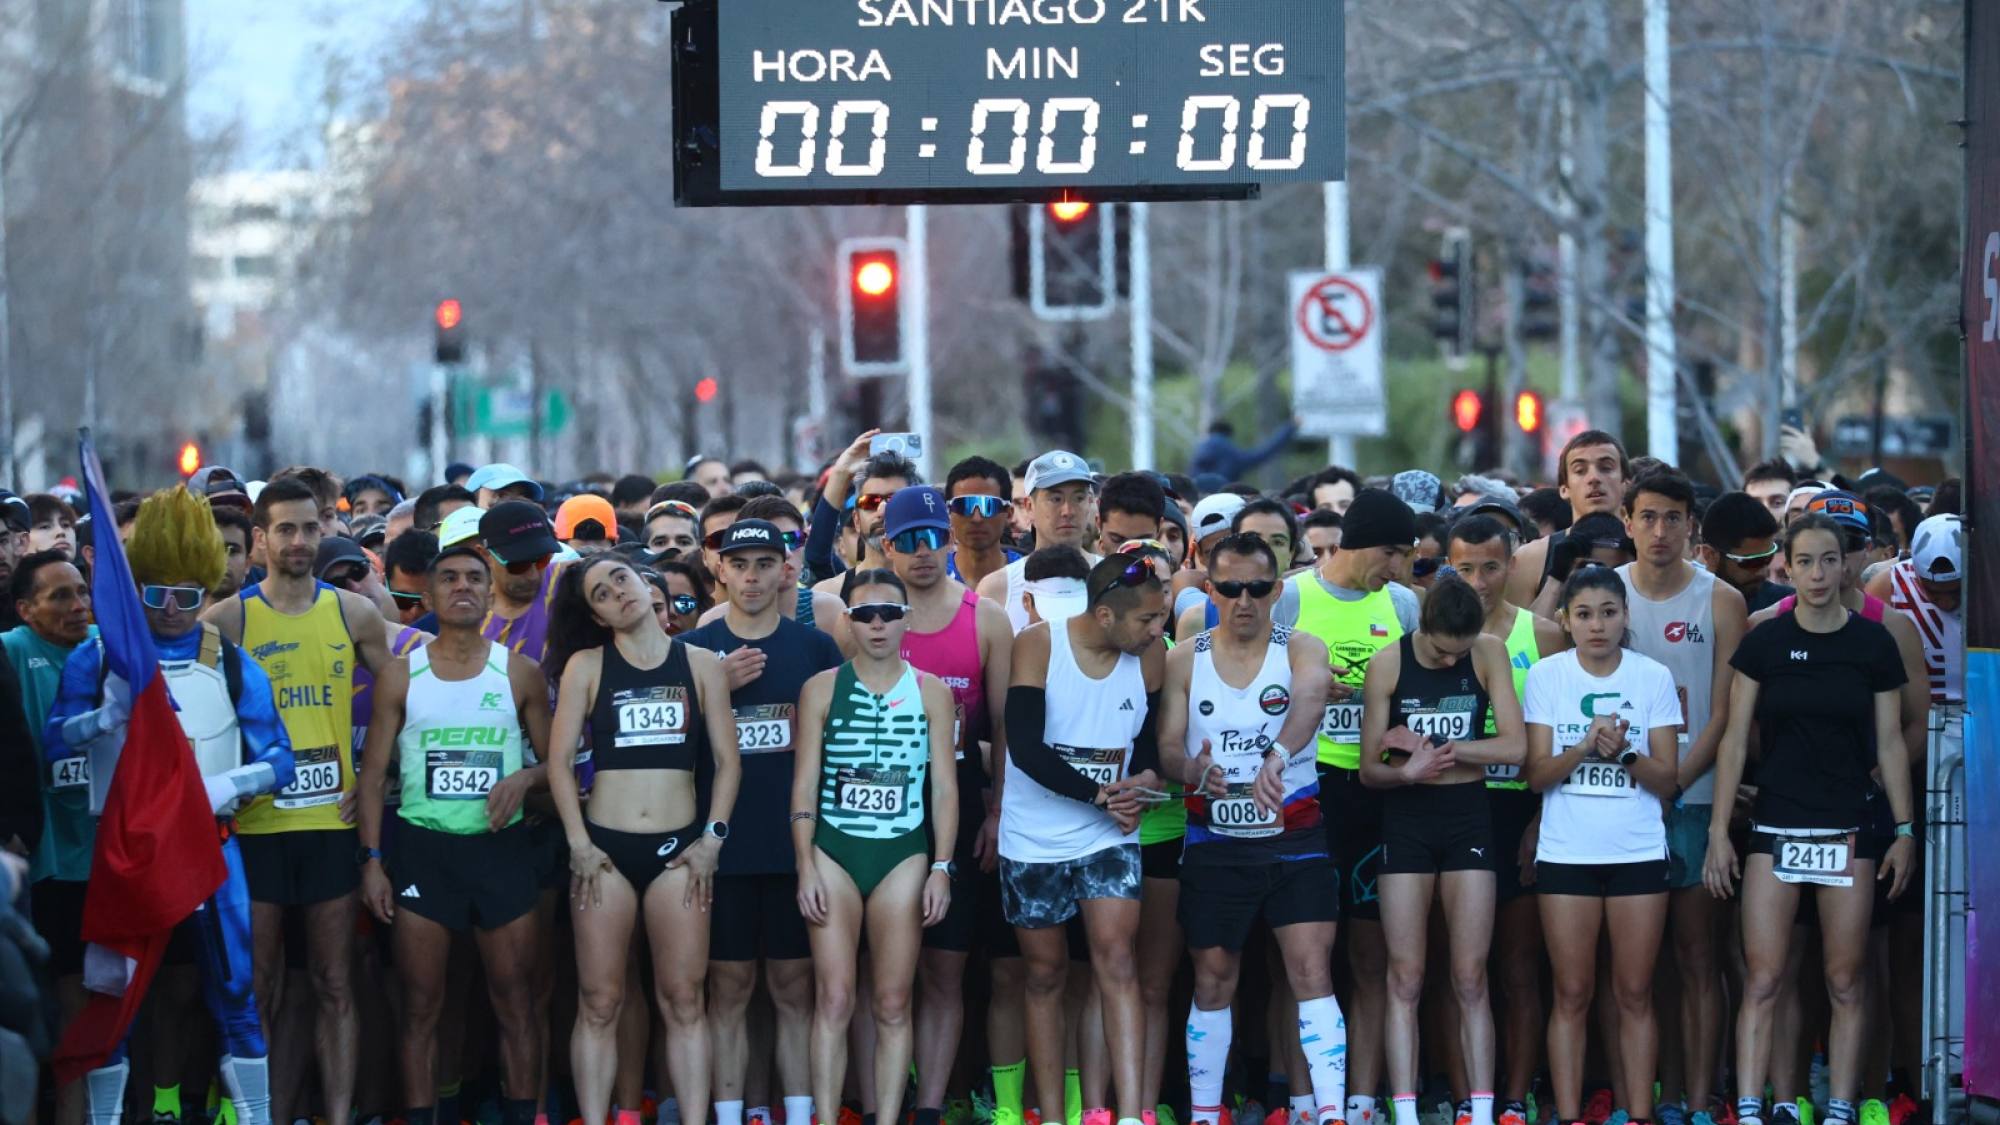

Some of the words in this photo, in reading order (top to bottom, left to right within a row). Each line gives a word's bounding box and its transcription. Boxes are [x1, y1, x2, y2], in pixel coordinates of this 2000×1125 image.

[858, 0, 1106, 26] SANTIAGO
[1122, 0, 1206, 23] 21K
[753, 49, 891, 82] HORA
[986, 46, 1079, 80] MIN
[1199, 43, 1285, 77] SEG
[731, 528, 770, 542] HOKA
[1687, 622, 1700, 632] LA
[1687, 632, 1705, 643] VIA
[279, 685, 333, 708] CHILE
[626, 705, 677, 729] 1343
[1413, 715, 1464, 737] 4109
[420, 727, 508, 748] PERU
[1557, 723, 1641, 735] CRS
[439, 770, 490, 792] 3542
[1576, 765, 1626, 788] 1666
[846, 787, 896, 811] 4236
[1787, 845, 1837, 869] 2411
